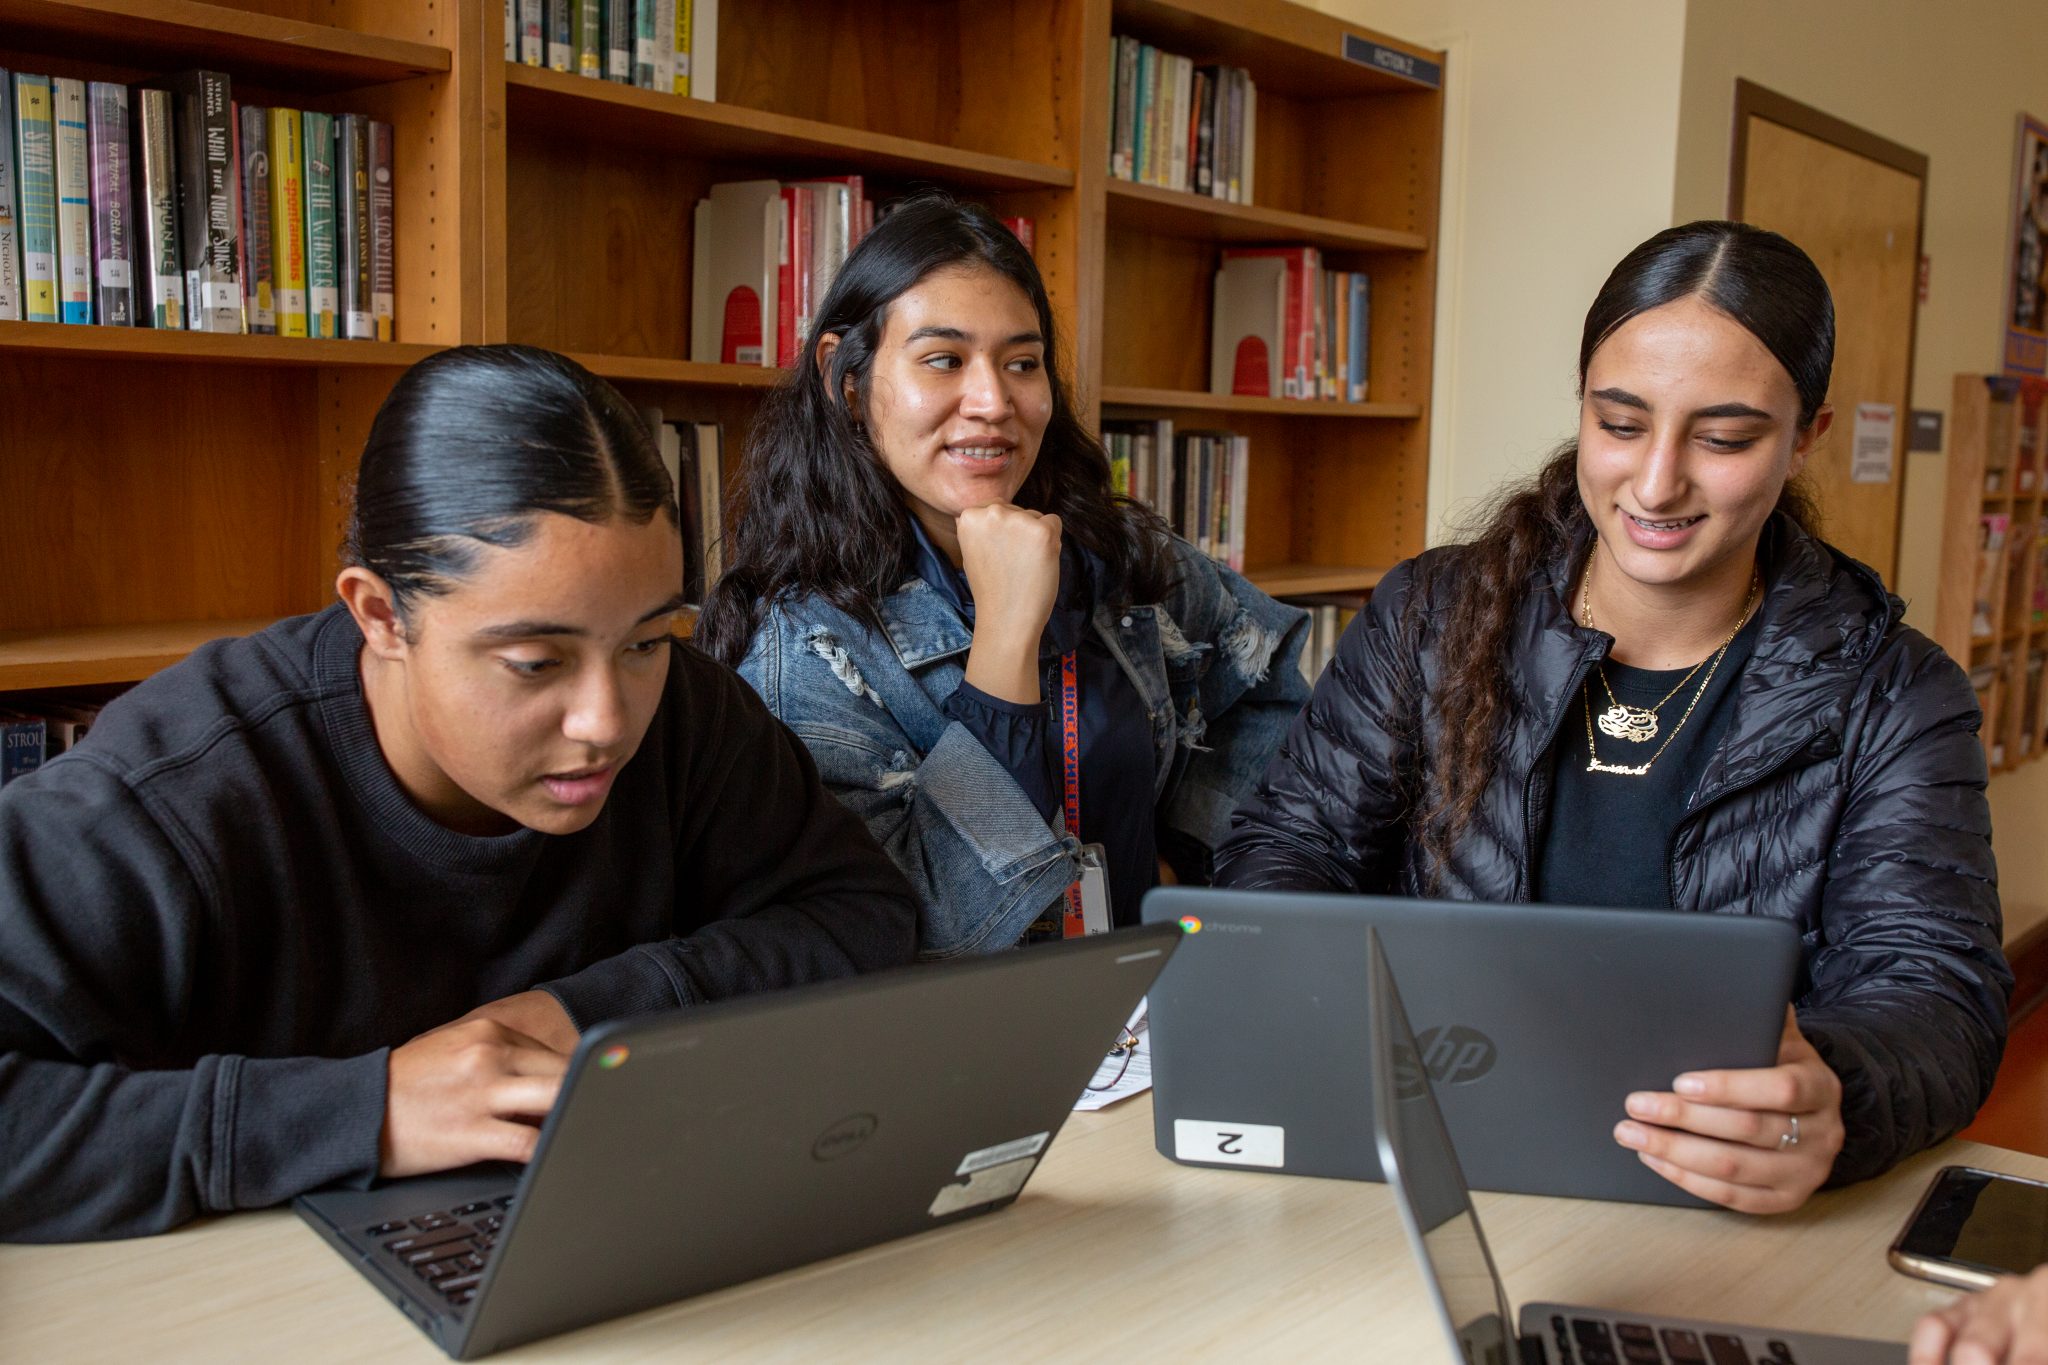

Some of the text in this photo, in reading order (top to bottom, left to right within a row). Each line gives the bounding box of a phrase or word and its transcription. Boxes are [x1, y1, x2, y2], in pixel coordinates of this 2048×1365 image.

[23, 131, 51, 175] SWAY
[108, 141, 121, 193] NATURAL
[110, 200, 122, 236] BORN
[207, 127, 232, 273] WHAT THE NIGHT SINGS
[284, 177, 302, 281] spontaneous
[1071, 888, 1084, 920] STAFF
[1204, 922, 1262, 935] chrome
[1422, 1026, 1490, 1084] hp
[1217, 1132, 1243, 1155] 2
